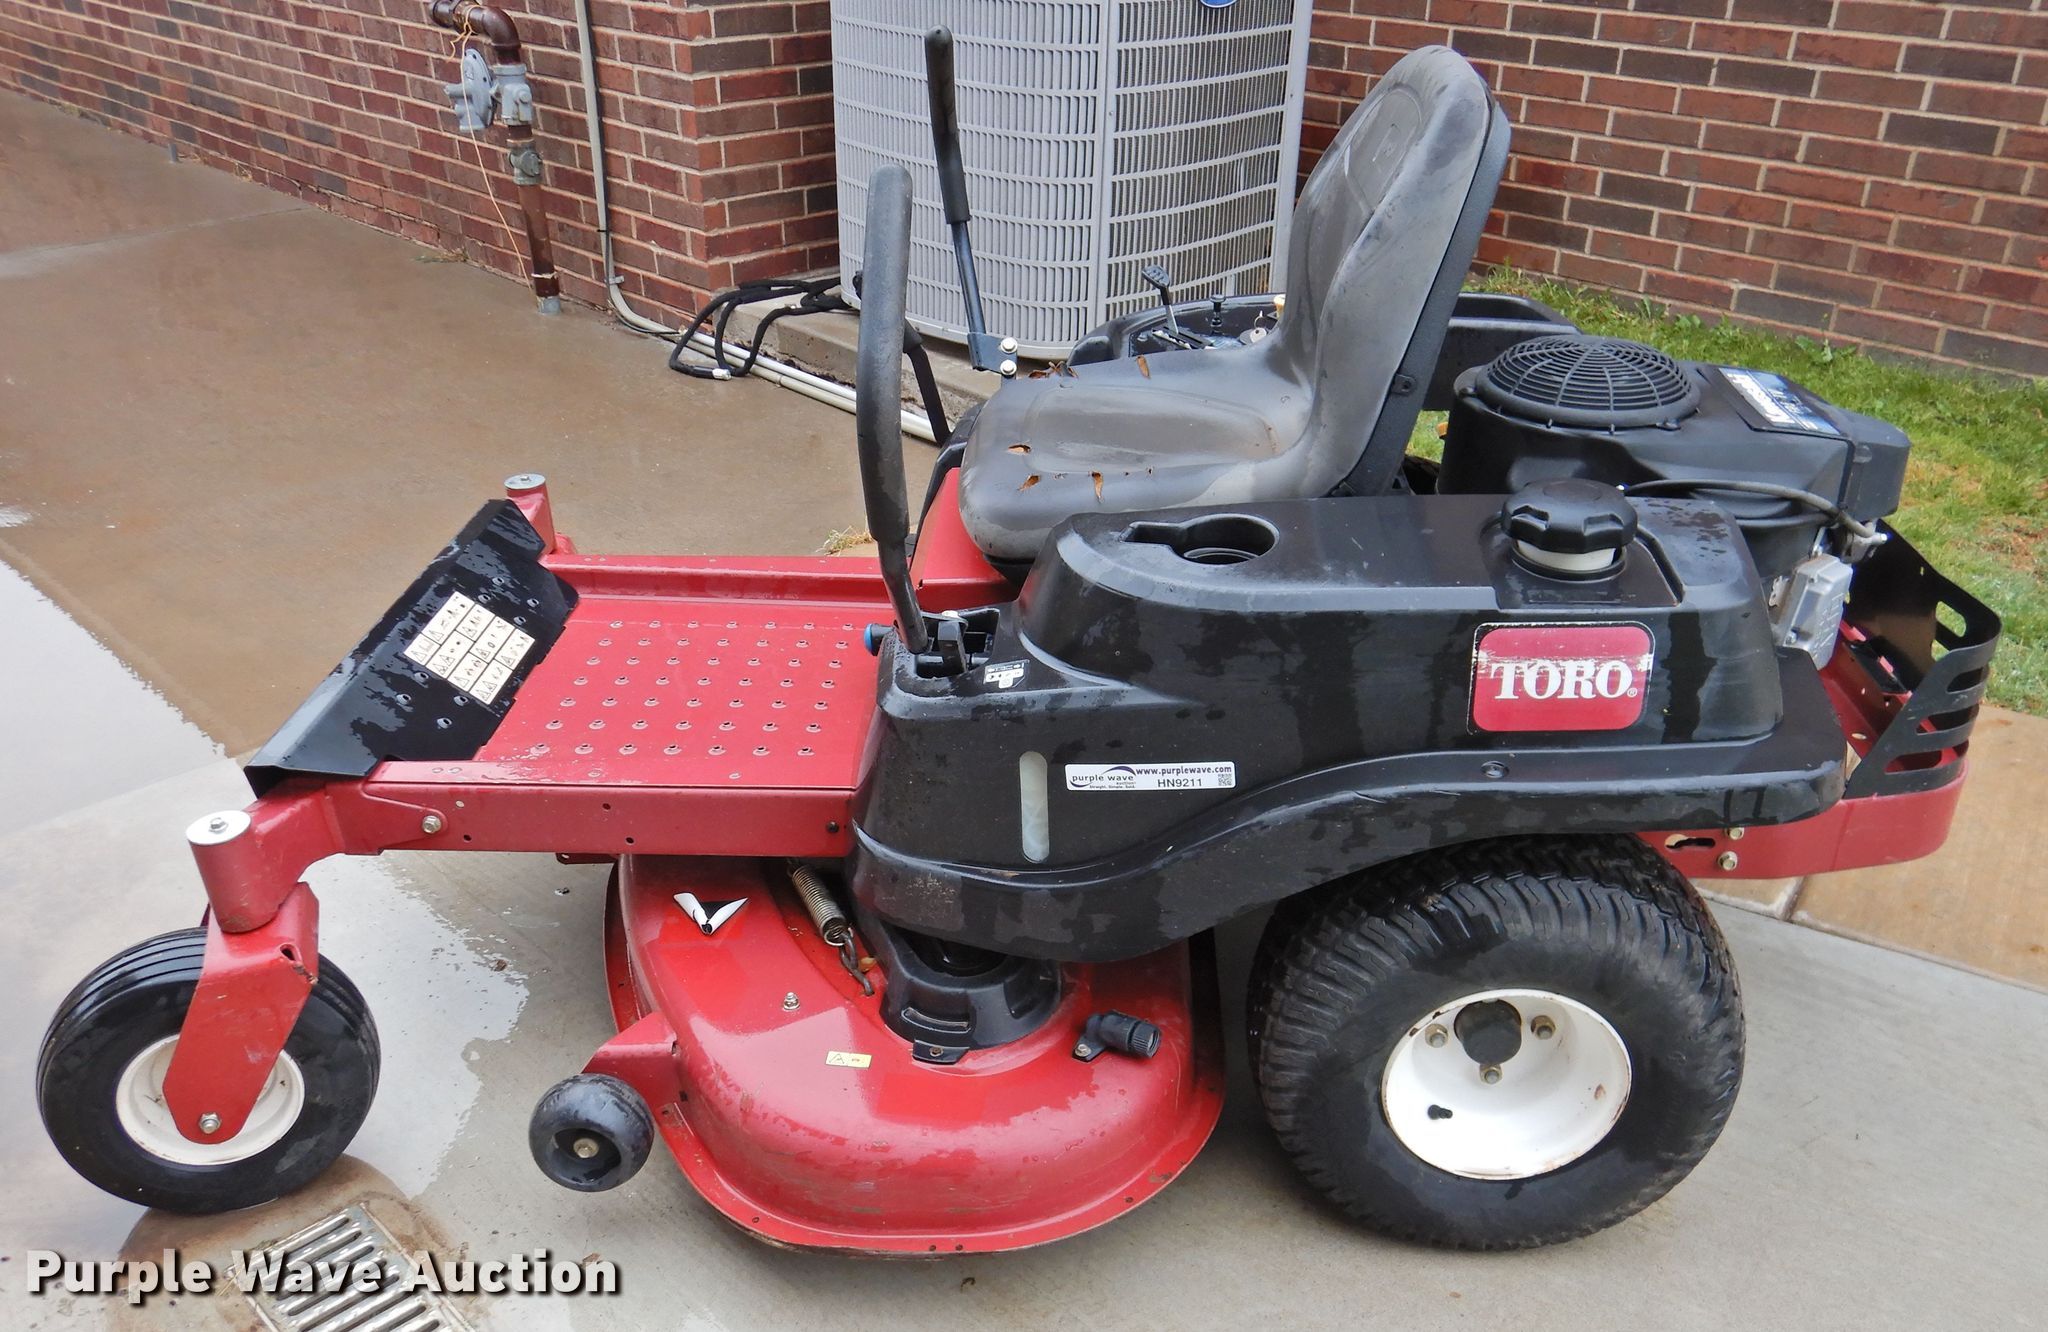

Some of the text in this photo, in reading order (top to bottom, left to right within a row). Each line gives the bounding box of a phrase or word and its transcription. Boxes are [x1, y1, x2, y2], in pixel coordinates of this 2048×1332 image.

[1491, 660, 1633, 699] TORO
[1136, 766, 1232, 776] www.purplewave.com
[1072, 774, 1104, 782] purple
[1157, 778, 1203, 788] HN9211
